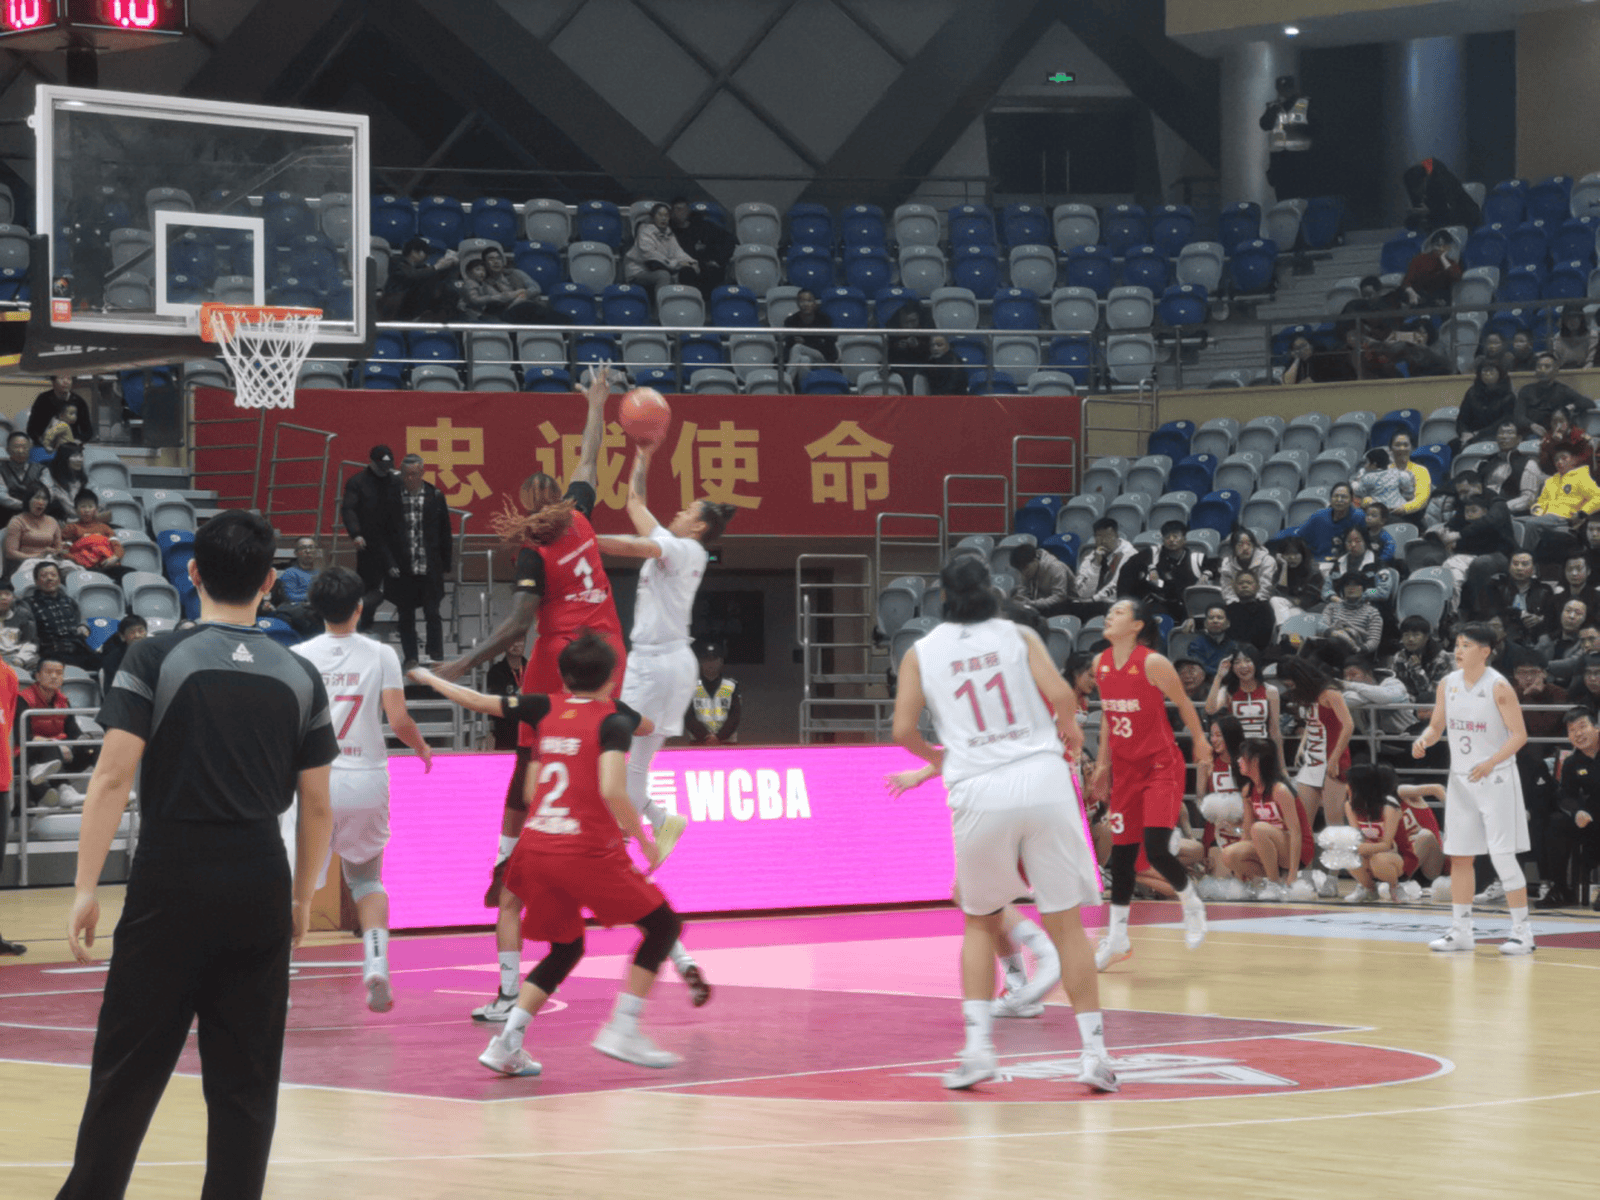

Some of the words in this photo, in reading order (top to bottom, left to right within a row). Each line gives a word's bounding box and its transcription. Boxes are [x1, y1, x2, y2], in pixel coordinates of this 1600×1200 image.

[404, 416, 895, 511] 忠诚使命
[334, 694, 364, 740] 7
[954, 672, 1016, 733] 11
[1111, 715, 1134, 738] 23
[1458, 735, 1472, 755] 3
[538, 760, 571, 817] 2
[684, 767, 812, 822] WCBA
